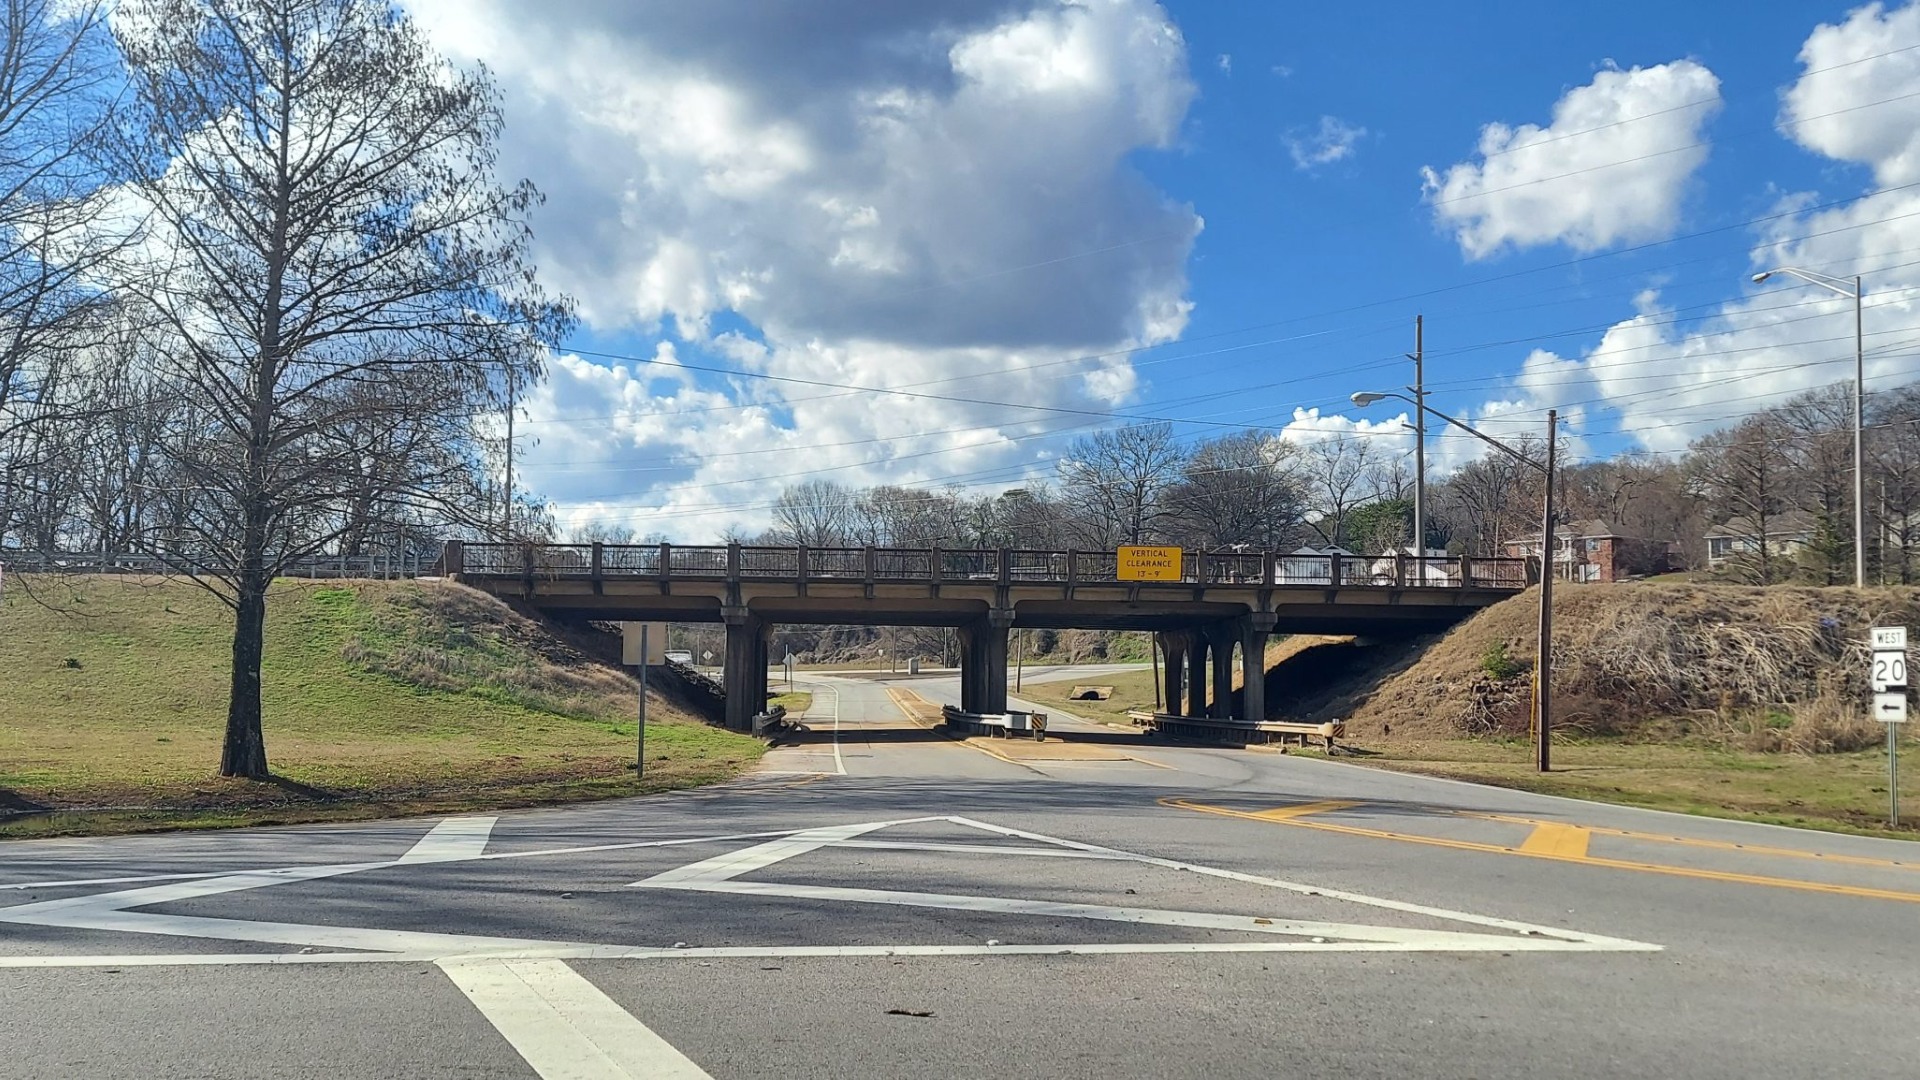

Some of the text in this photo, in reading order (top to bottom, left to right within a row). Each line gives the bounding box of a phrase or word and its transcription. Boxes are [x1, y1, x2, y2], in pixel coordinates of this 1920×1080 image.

[1131, 550, 1168, 558] VERTICAL
[1877, 632, 1901, 643] WEST
[1876, 660, 1904, 681] 20
